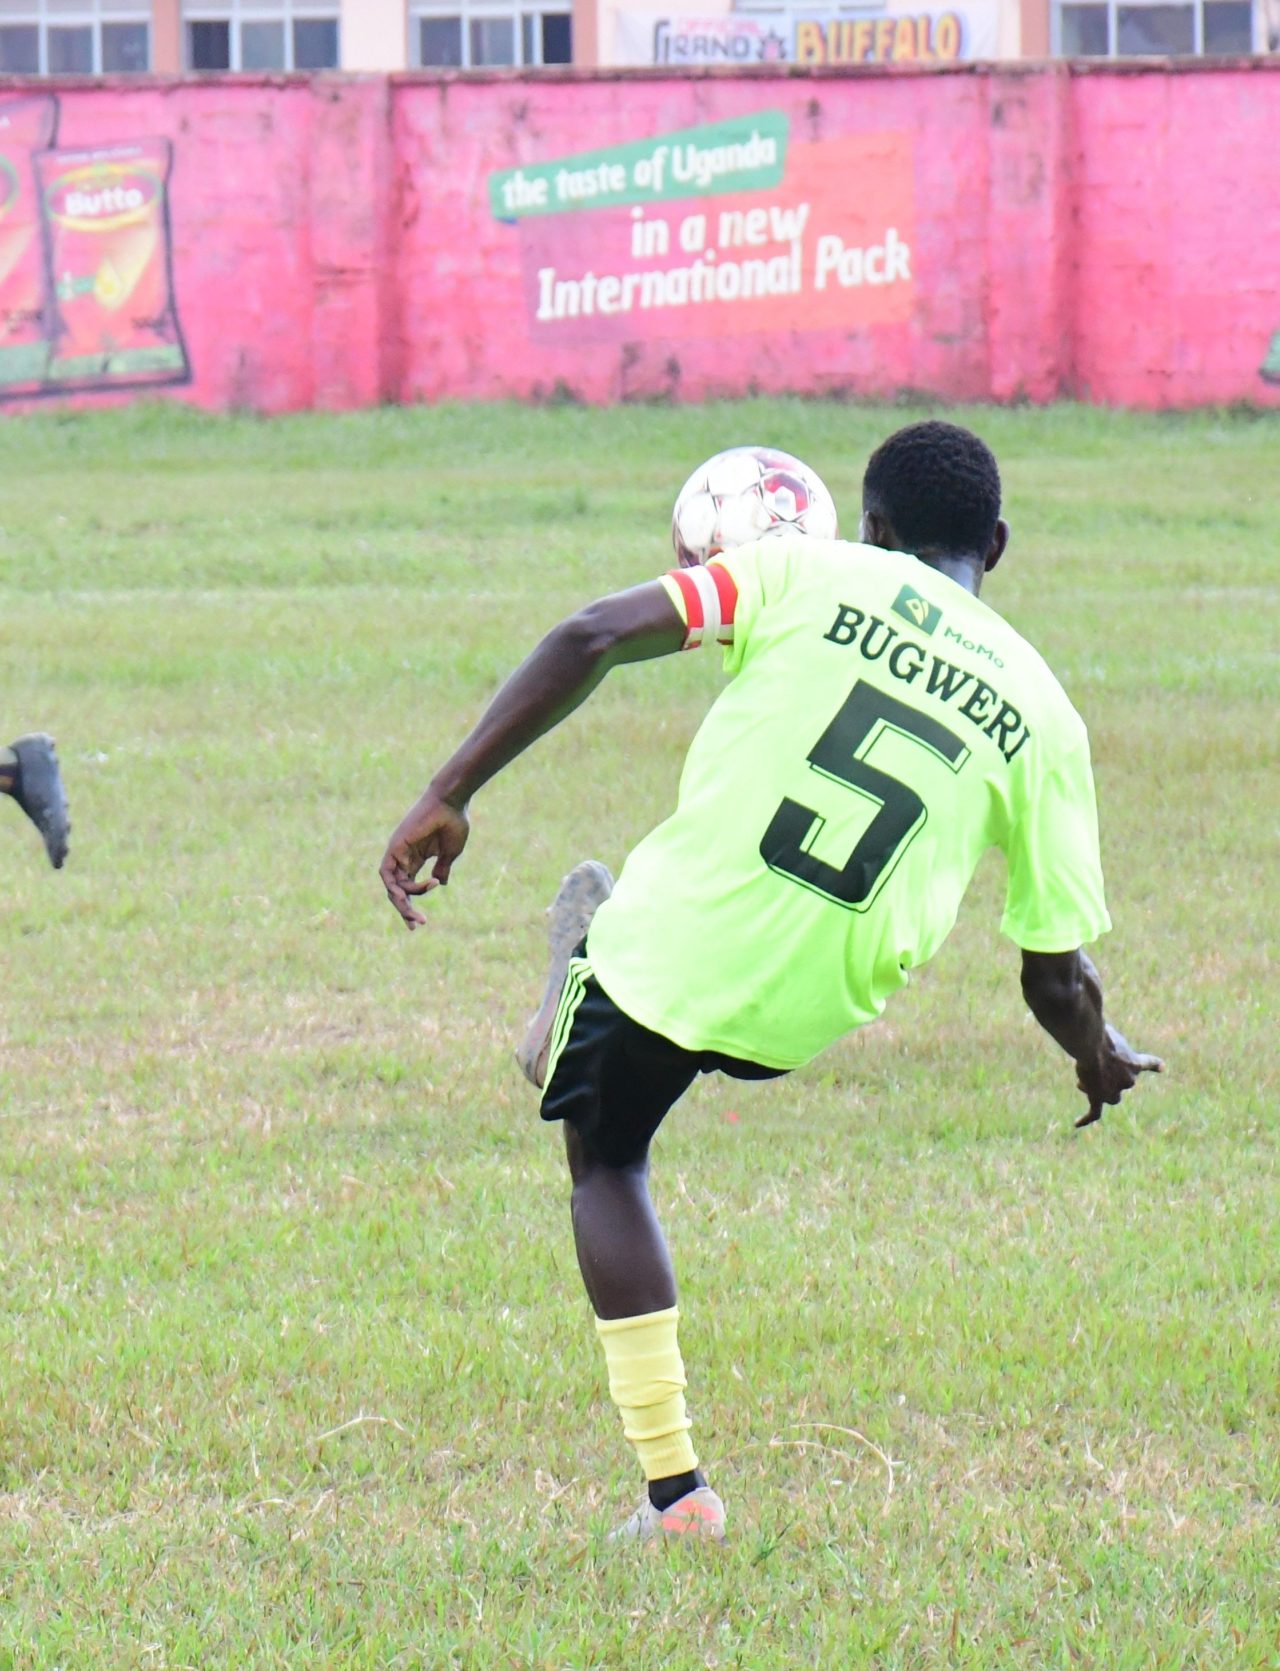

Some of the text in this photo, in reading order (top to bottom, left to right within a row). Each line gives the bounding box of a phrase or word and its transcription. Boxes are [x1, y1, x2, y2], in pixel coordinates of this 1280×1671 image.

[795, 12, 961, 65] BUFFALO
[65, 186, 143, 216] Butto
[501, 130, 777, 211] the taste of Uganda
[631, 203, 810, 258] in a new
[536, 227, 911, 320] International Pack
[943, 625, 1006, 669] MoMo
[823, 603, 1030, 764] BUGWERI
[759, 678, 972, 914] 5
